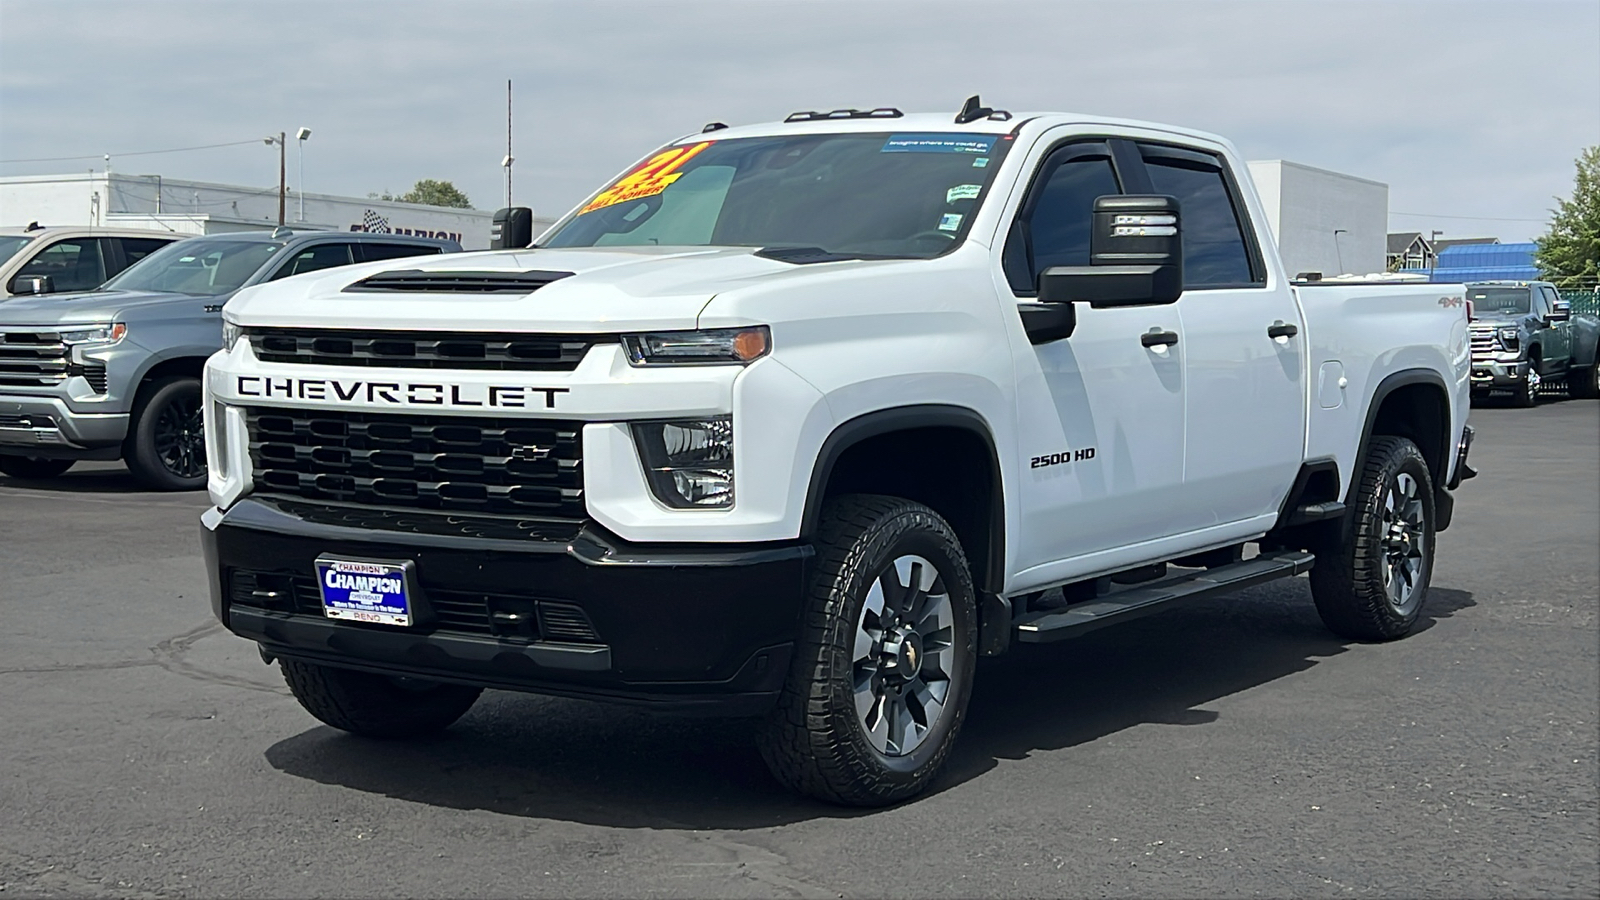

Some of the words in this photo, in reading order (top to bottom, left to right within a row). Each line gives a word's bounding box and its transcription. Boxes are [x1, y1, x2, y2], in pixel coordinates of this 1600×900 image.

[237, 376, 570, 408] CHEVROLET
[1031, 452, 1071, 469] 2500
[1075, 448, 1095, 461] HD
[340, 564, 380, 573] CHAMPION
[326, 570, 401, 594] CHAMPION
[351, 593, 381, 601] CHEVROLET
[354, 613, 380, 621] RENO
